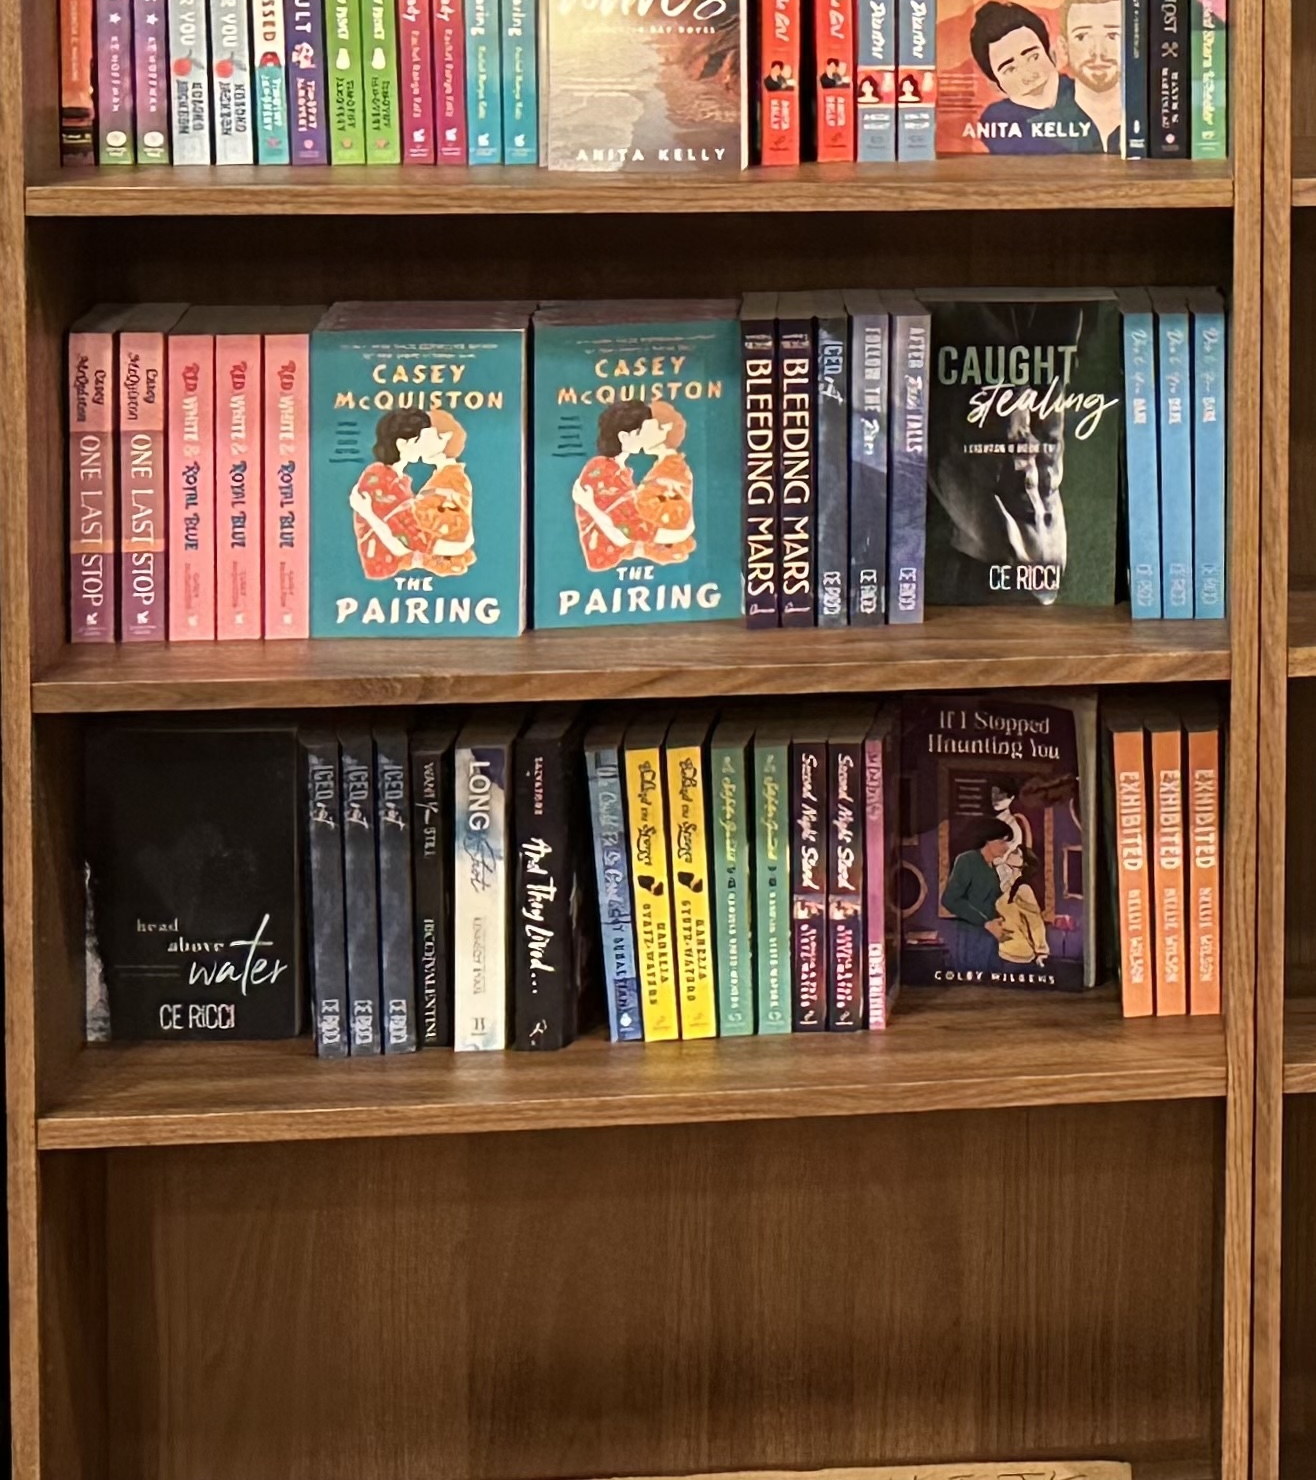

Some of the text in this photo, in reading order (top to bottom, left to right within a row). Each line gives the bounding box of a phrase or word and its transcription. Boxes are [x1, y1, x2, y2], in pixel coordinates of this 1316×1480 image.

[180, 11, 197, 46] YOU
[221, 13, 237, 47] YOU
[962, 122, 1091, 138] ANITA KELLY
[576, 148, 726, 162] ANITA KELLY
[181, 362, 200, 392] RED
[230, 361, 248, 390] RED
[372, 364, 465, 384] CASEY
[594, 356, 686, 378] CASEY
[937, 345, 1078, 385] CAUGHT
[333, 391, 503, 410] McQUISTON
[557, 381, 723, 405] McQUISTON
[966, 375, 1120, 440] stealing
[746, 358, 774, 505] BLEEDING
[782, 358, 809, 504] BLEEDING
[182, 461, 200, 510] ROYAL
[229, 460, 248, 508] ROYAL
[79, 435, 104, 607] ONE LAST STOP
[131, 434, 154, 606] ONE LAST STOP
[183, 512, 200, 551] BLUE
[230, 511, 246, 549] BLUE
[746, 516, 775, 596] MARS
[782, 516, 810, 595] MARS
[394, 576, 433, 591] THE
[616, 566, 654, 581] THE
[989, 565, 1061, 590] CE RICCI
[335, 597, 501, 625] PAIRING
[559, 583, 722, 616] PAIRING
[974, 712, 1050, 735] Stopped
[928, 734, 1060, 760] Haunting You
[468, 761, 490, 831] LONG
[1119, 771, 1143, 871] EXHIBITED
[1159, 769, 1181, 870] EXHIBITED
[1194, 768, 1215, 869] EXHIBITED
[521, 837, 553, 874] And
[522, 878, 557, 922] They
[136, 919, 179, 933] head
[167, 937, 224, 953] above
[188, 913, 289, 996] water
[934, 970, 984, 982] COLBY
[159, 1004, 235, 1030] CE RICCI
